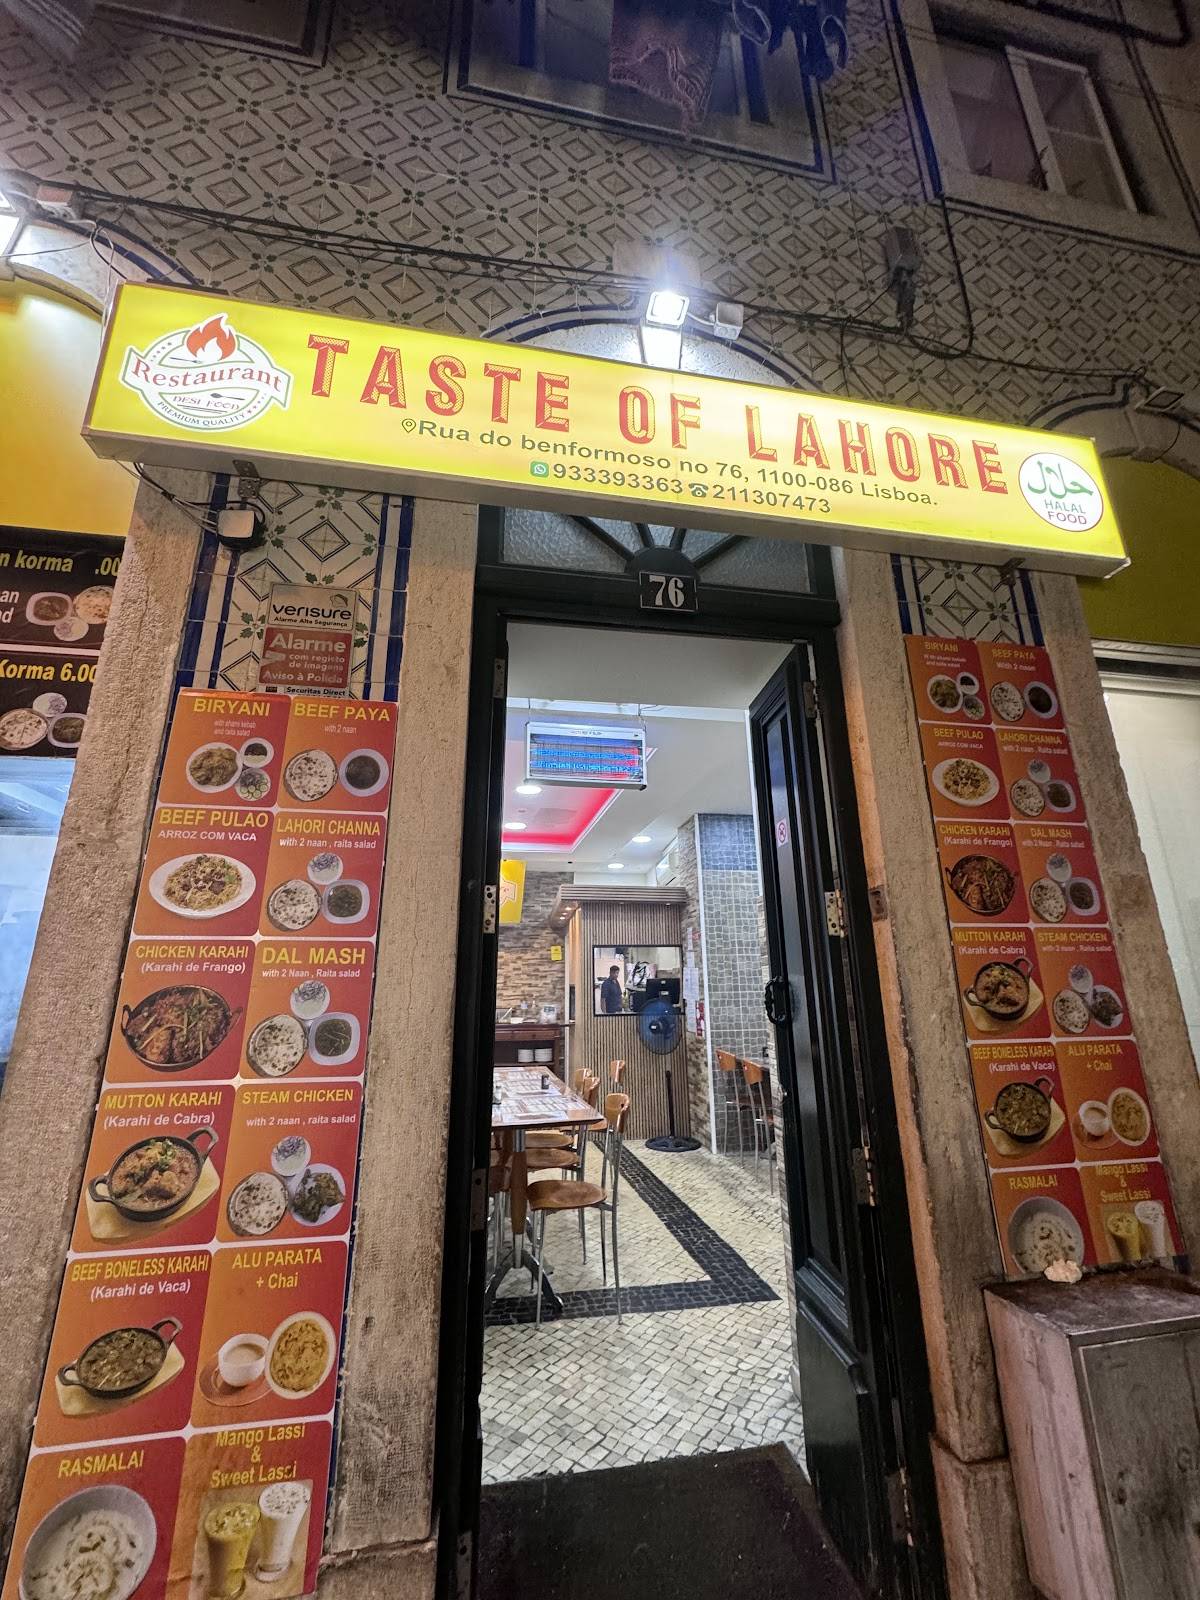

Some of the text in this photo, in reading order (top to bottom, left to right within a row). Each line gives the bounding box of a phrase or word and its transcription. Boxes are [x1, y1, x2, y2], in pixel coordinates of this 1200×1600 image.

[131, 358, 282, 392] Restaurant
[206, 401, 240, 410] FOOD
[157, 401, 245, 426] PREMIUM QUALITY
[308, 333, 1009, 495] TASTE OF LAHORE
[418, 420, 938, 506] Rua do benformoso no 76, 1100-086 Lisboa.
[1028, 461, 1093, 499] حلال
[553, 463, 831, 513] 933393363 211307473
[1045, 499, 1086, 513] HALAL
[1048, 511, 1087, 524] FOOD
[15, 550, 73, 572] korma
[649, 575, 685, 608] 76
[273, 604, 351, 619] verisure
[270, 633, 346, 652] Alarme
[925, 642, 958, 652] BIRYANI
[0, 659, 55, 680] Korma
[263, 670, 294, 680] Aviso
[193, 699, 270, 717] BIRYANI
[294, 702, 390, 721] BEEF PAYA
[933, 728, 984, 740] BEEF PULAO
[1000, 733, 1062, 745] LAHORI CHANNA
[160, 810, 269, 828] BEEF PULAO
[276, 819, 380, 836] LAHORI CHANNA
[940, 825, 1010, 836] CHICKEN KARAHI
[1031, 828, 1072, 838] DAL MASH
[158, 830, 257, 841] ARROZ COM VACA
[944, 837, 971, 846] (Karahi
[984, 838, 1013, 848] Frango)
[279, 838, 298, 847] with
[299, 838, 305, 847] 2
[334, 839, 352, 848] raita
[354, 840, 376, 849] salad
[955, 931, 1026, 942] MUTTON KARAHI
[1038, 932, 1107, 942] STEAM CHICKEN
[136, 946, 249, 959] CHICKEN KARAHI
[262, 948, 366, 965] DAL MASH
[959, 946, 1026, 955] (Karahi de Cabra)
[141, 962, 246, 974] (Karahi de Frango)
[262, 969, 360, 977] with 2 Naan Raita salad
[974, 1048, 991, 1059] BEEF
[992, 1046, 1028, 1058] BONELESS
[1068, 1045, 1123, 1056] ALU PARATA
[989, 1061, 1056, 1073] (Karahi de Vaca)
[1093, 1060, 1112, 1071] Chai
[105, 1091, 222, 1109] MUTTON KARAHI
[242, 1089, 353, 1104] STEAM CHICKEN
[104, 1112, 215, 1128] (Karahi de Cabra)
[246, 1114, 356, 1126] with 2 naan raita salad
[1126, 1164, 1148, 1174] Lassi
[1009, 1174, 1058, 1189] RASMALAI
[1100, 1188, 1151, 1202] Sweet Lassi
[232, 1248, 322, 1269] ALU PARATA
[72, 1255, 209, 1282] BEEF BONELESS KARAHI
[256, 1273, 298, 1289] + Chai
[90, 1278, 191, 1302] (Karahi de Vaca)
[216, 1425, 305, 1448] Mango Lassi
[251, 1445, 261, 1463] &
[58, 1450, 144, 1478] RASMALAI
[210, 1466, 255, 1488] Sweet
